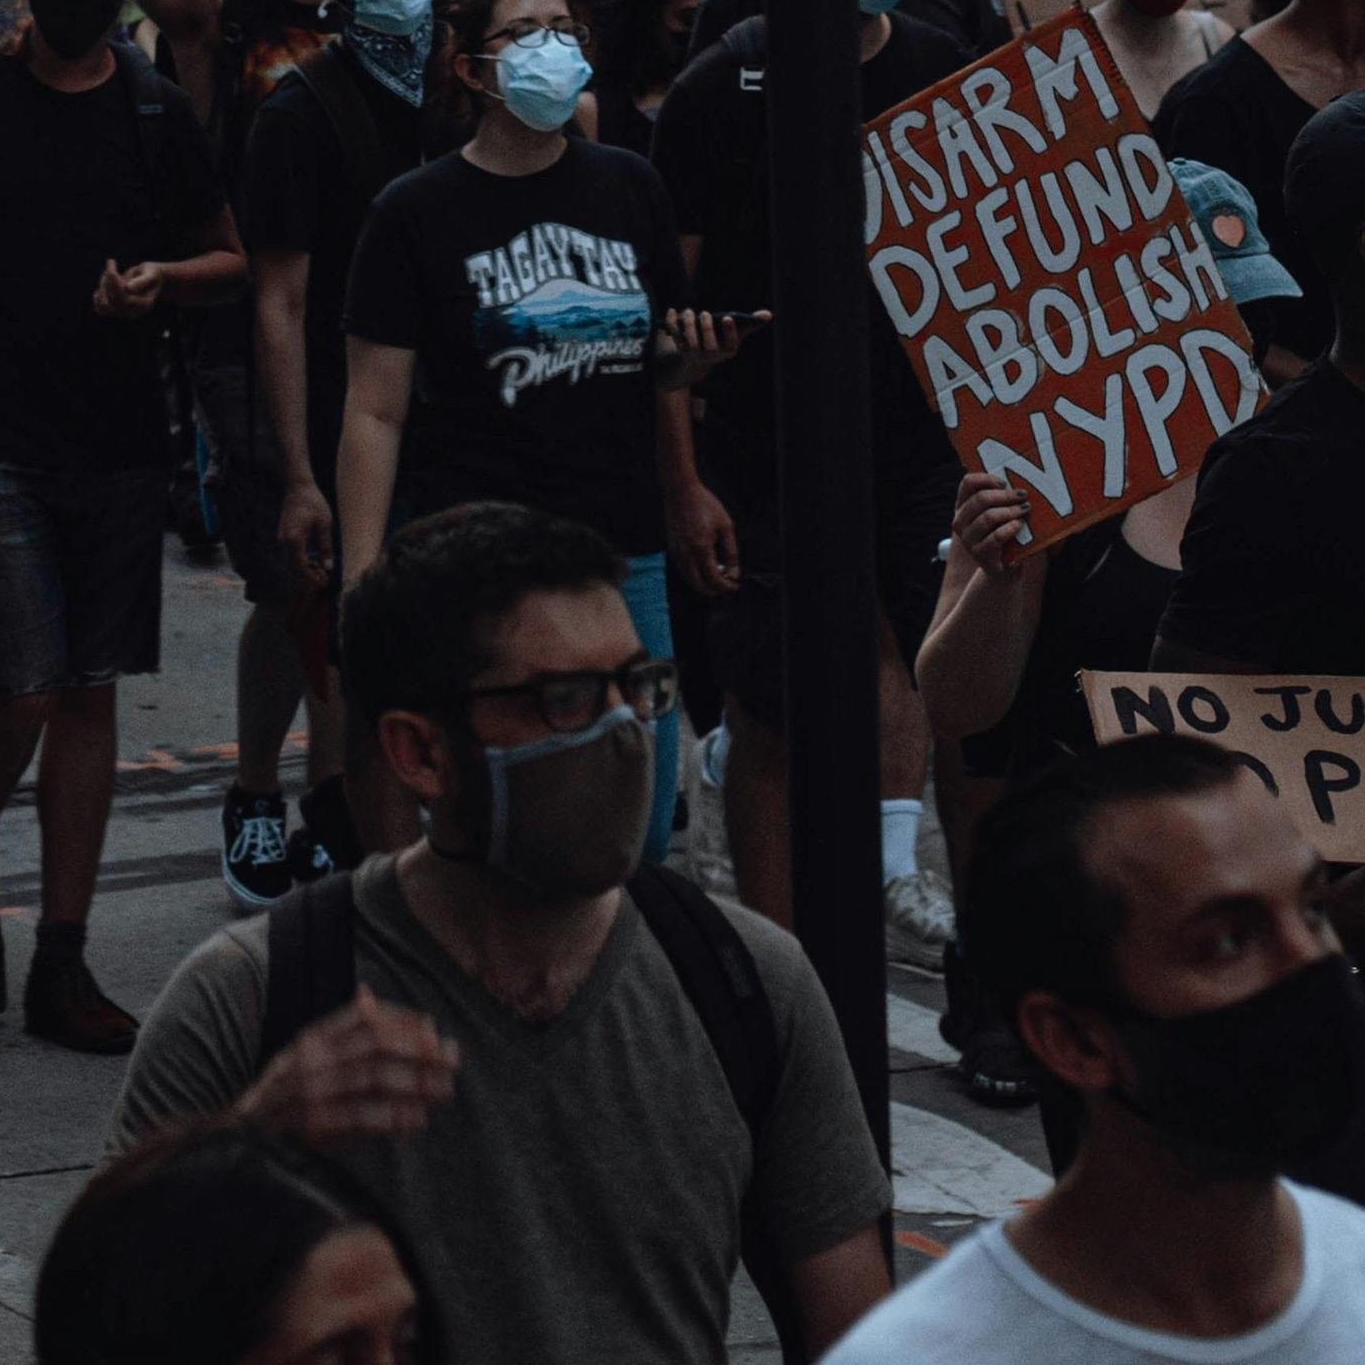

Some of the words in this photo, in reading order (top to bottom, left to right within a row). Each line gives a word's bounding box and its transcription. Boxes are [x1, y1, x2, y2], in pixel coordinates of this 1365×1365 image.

[463, 221, 642, 309] TAGAYTAY
[868, 132, 1175, 339] DEFUND
[486, 335, 646, 409] Philippines
[922, 219, 1230, 430] ABOLISH
[975, 327, 1261, 547] NYPD
[1110, 685, 1231, 735] NO
